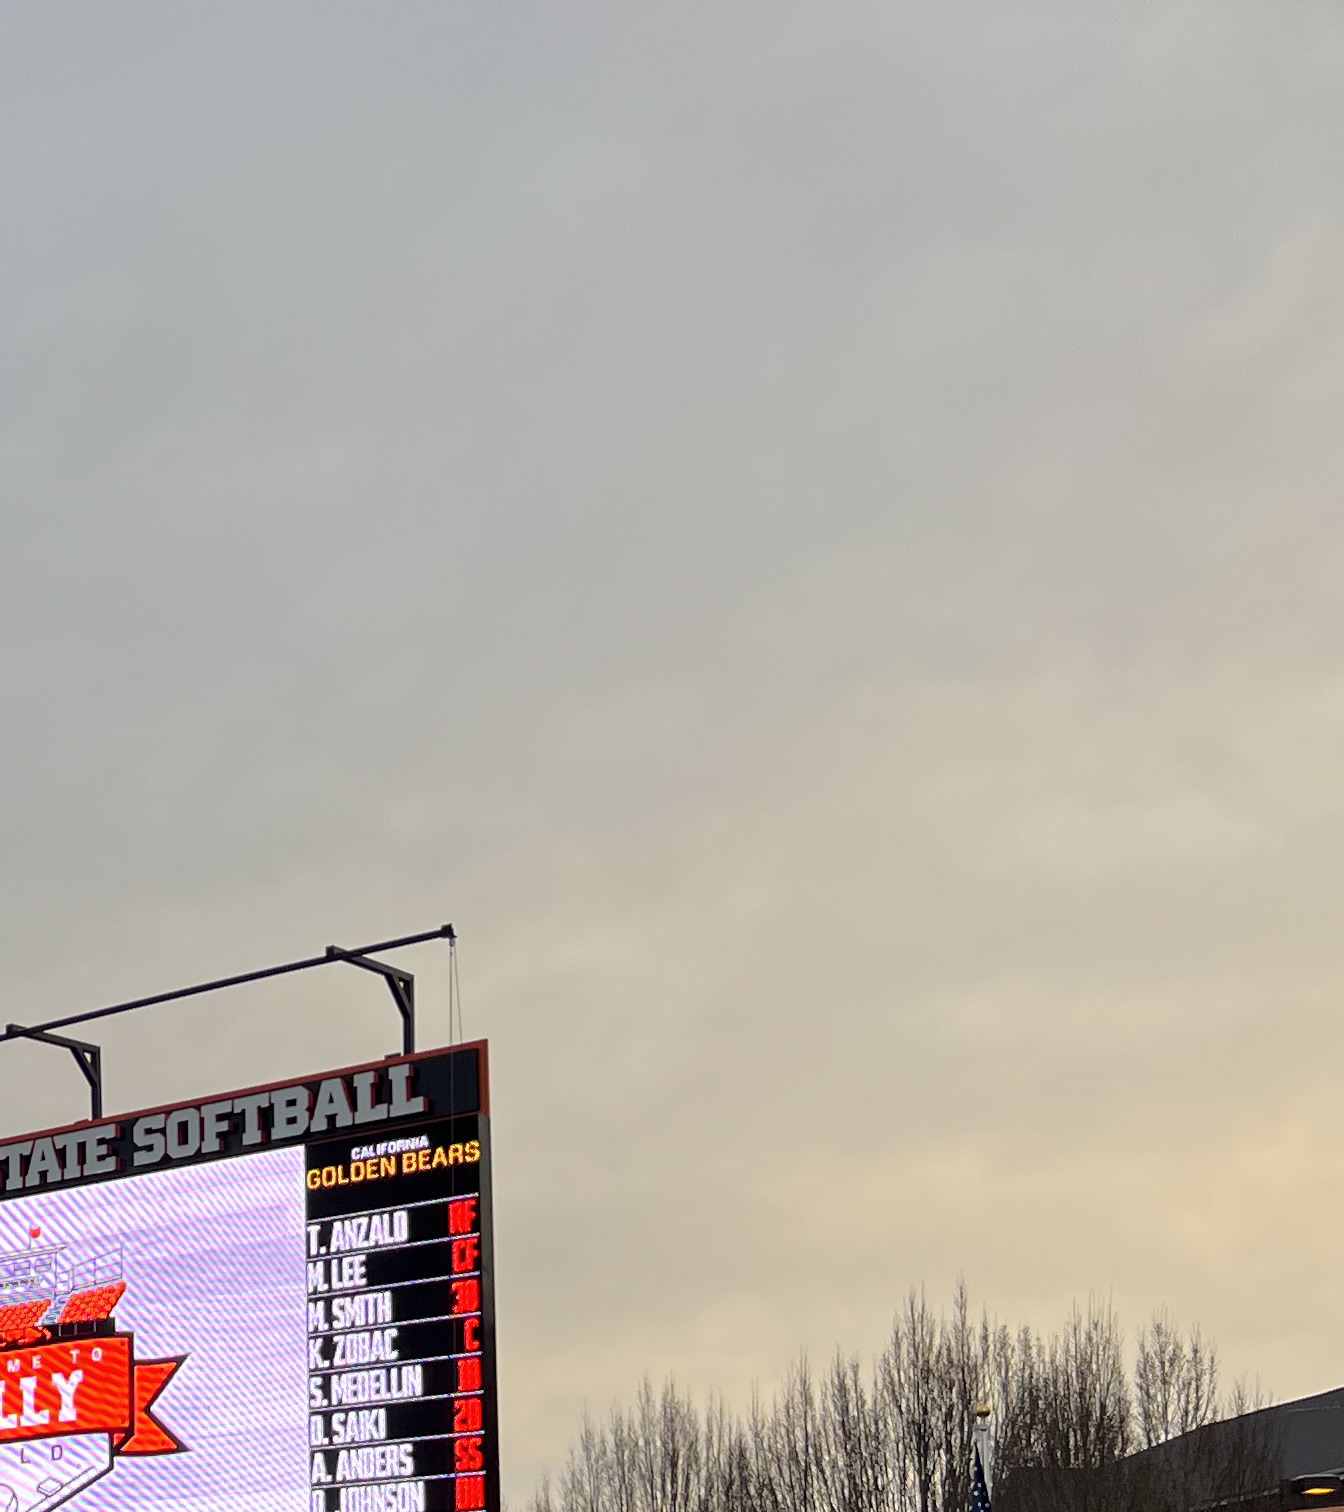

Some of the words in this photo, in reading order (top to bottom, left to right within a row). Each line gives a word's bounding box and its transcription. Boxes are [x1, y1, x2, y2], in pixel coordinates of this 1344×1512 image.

[132, 1063, 425, 1167] SOFTBALL
[351, 1135, 429, 1160] CALIFORNIA
[307, 1155, 396, 1190] GOLDEN
[402, 1140, 481, 1173] BEARS
[307, 1225, 326, 1255] T.
[332, 1255, 366, 1289] LEE
[332, 1292, 392, 1329] SMITH
[464, 1318, 479, 1350] C
[71, 1347, 102, 1365] TO
[309, 1338, 329, 1369] K.
[310, 1376, 328, 1406] S.
[332, 1408, 386, 1444] SAIKI
[312, 1452, 332, 1484] A.
[336, 1443, 414, 1481] ANDERS
[455, 1437, 484, 1471] SS
